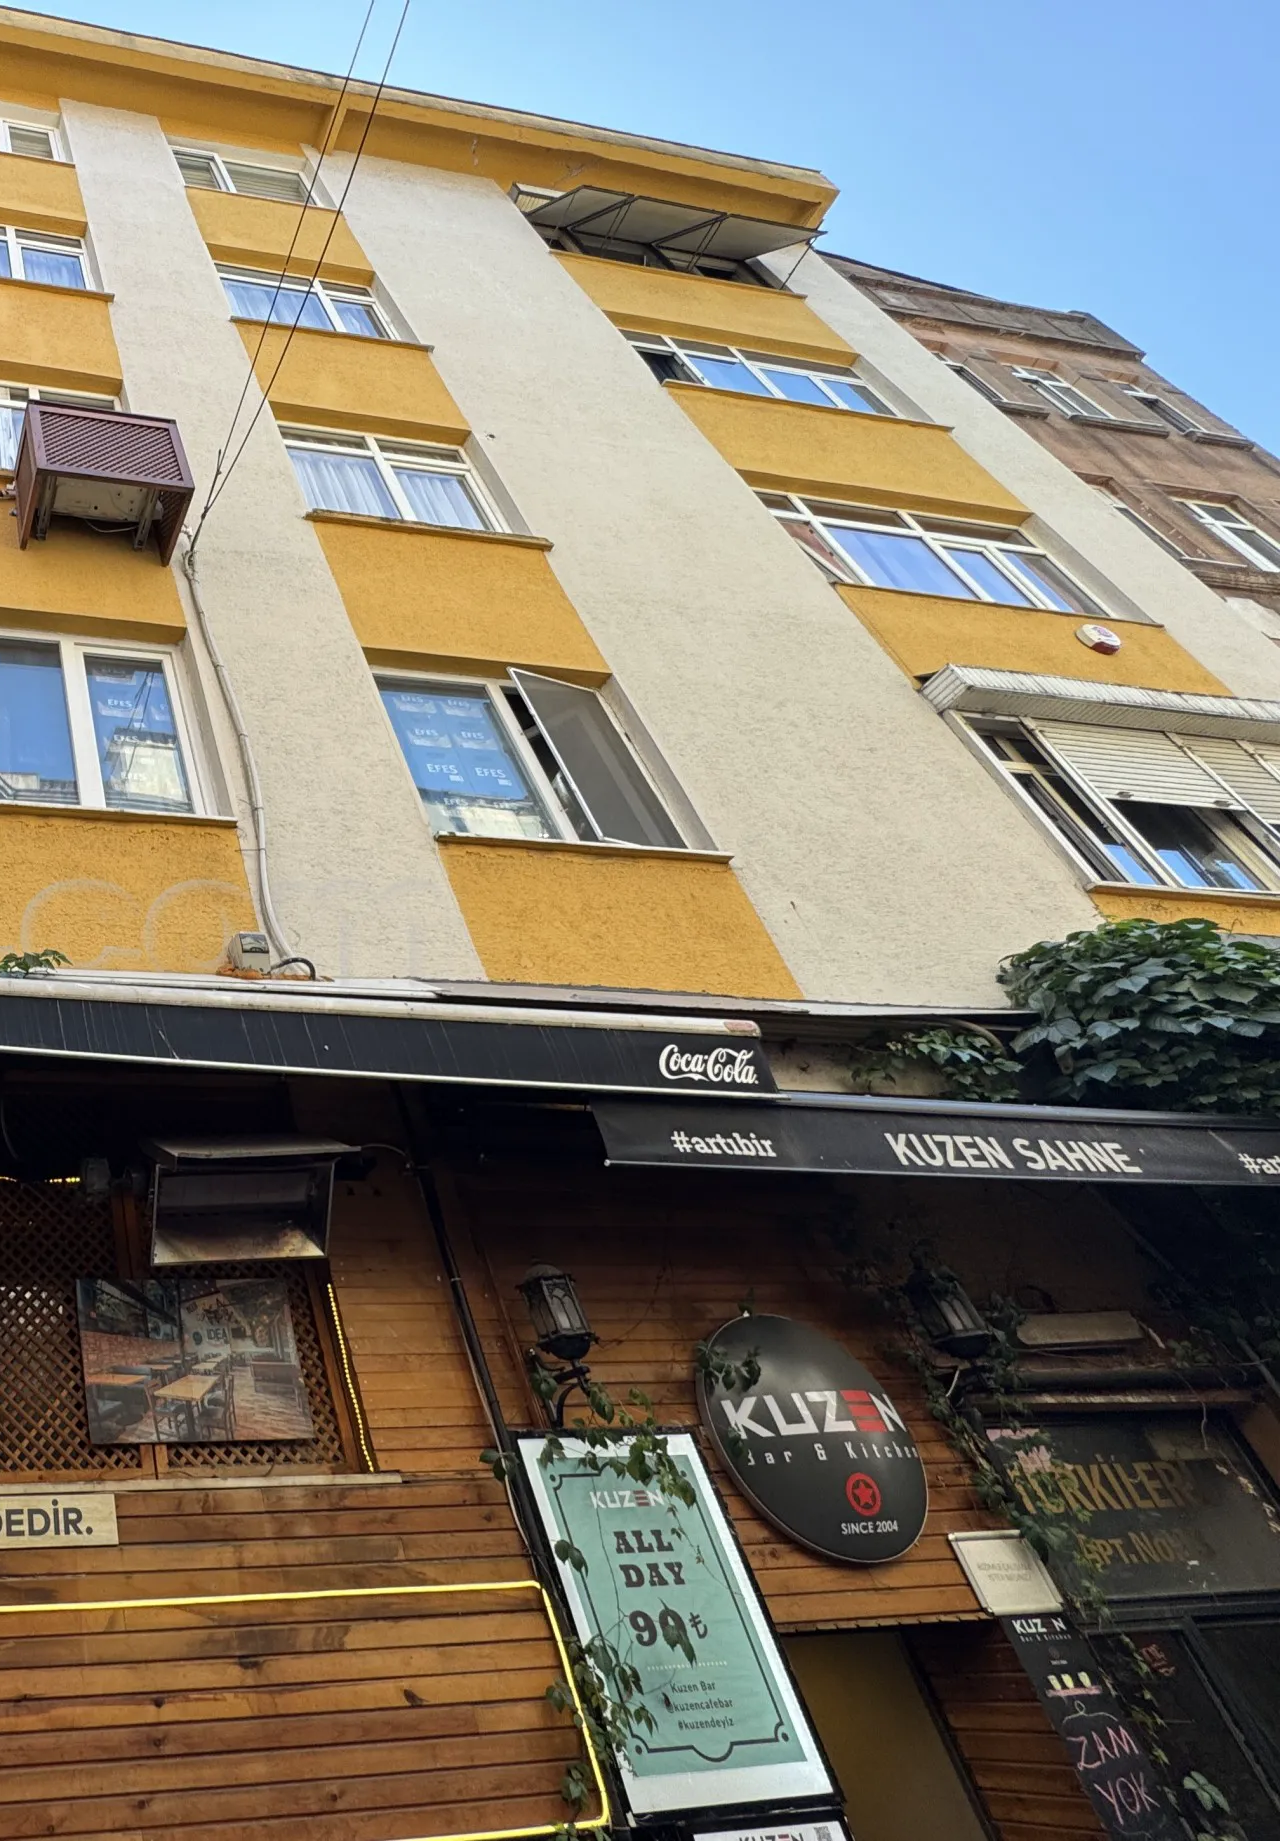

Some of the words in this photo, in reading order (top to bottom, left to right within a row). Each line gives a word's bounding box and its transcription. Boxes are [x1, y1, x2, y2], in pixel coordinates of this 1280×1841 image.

[426, 763, 459, 775] EFES
[474, 767, 507, 779] EFES
[659, 1044, 756, 1084] Coca-Cola
[884, 1132, 1014, 1169] KUZEN
[1012, 1138, 1142, 1173] SAHNE
[721, 1389, 907, 1440] KUZEN
[589, 1488, 666, 1509] KUZEN
[841, 1521, 874, 1535] SINCE
[876, 1520, 899, 1533] 2004
[613, 1529, 674, 1554] ALL
[619, 1562, 686, 1588] DAY
[670, 1682, 699, 1693] Kuzen
[700, 1681, 716, 1691] Bar
[1066, 1725, 1139, 1771] ZAM
[1093, 1771, 1161, 1826] YOK
